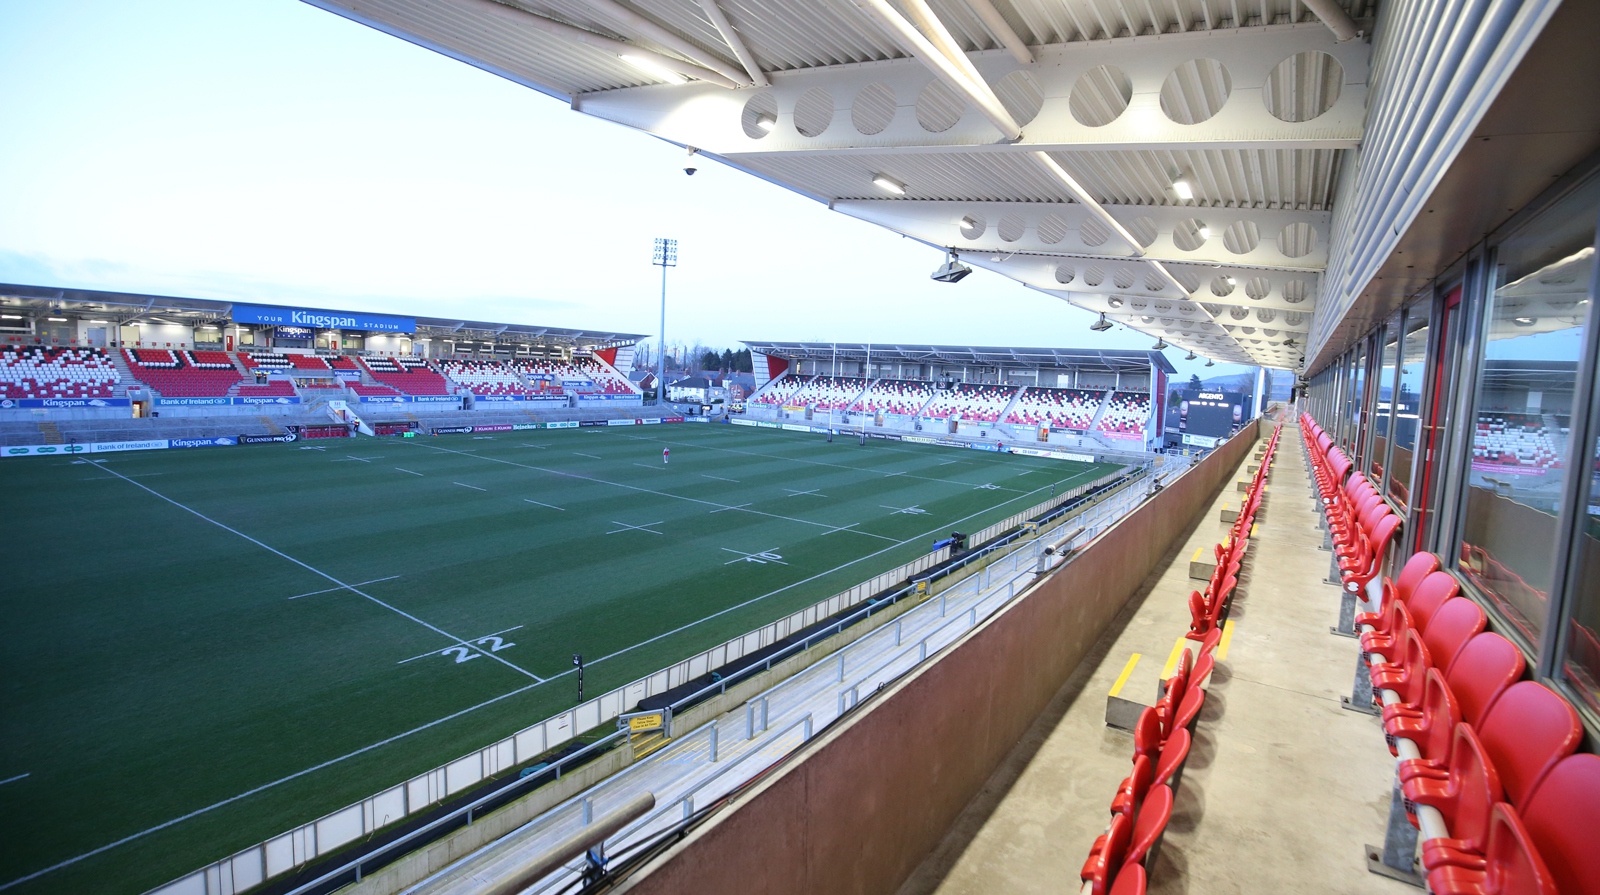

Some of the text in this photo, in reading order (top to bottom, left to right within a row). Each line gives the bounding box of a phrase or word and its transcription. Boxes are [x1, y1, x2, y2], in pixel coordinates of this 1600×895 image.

[257, 310, 399, 330] YOUR Kingspan STADIUM
[277, 325, 311, 335] Kingspan
[43, 399, 85, 408] Kingspan
[243, 397, 274, 405] Kingspan
[172, 438, 212, 448] Kingspan
[746, 552, 783, 564] 10
[441, 636, 517, 664] 22
